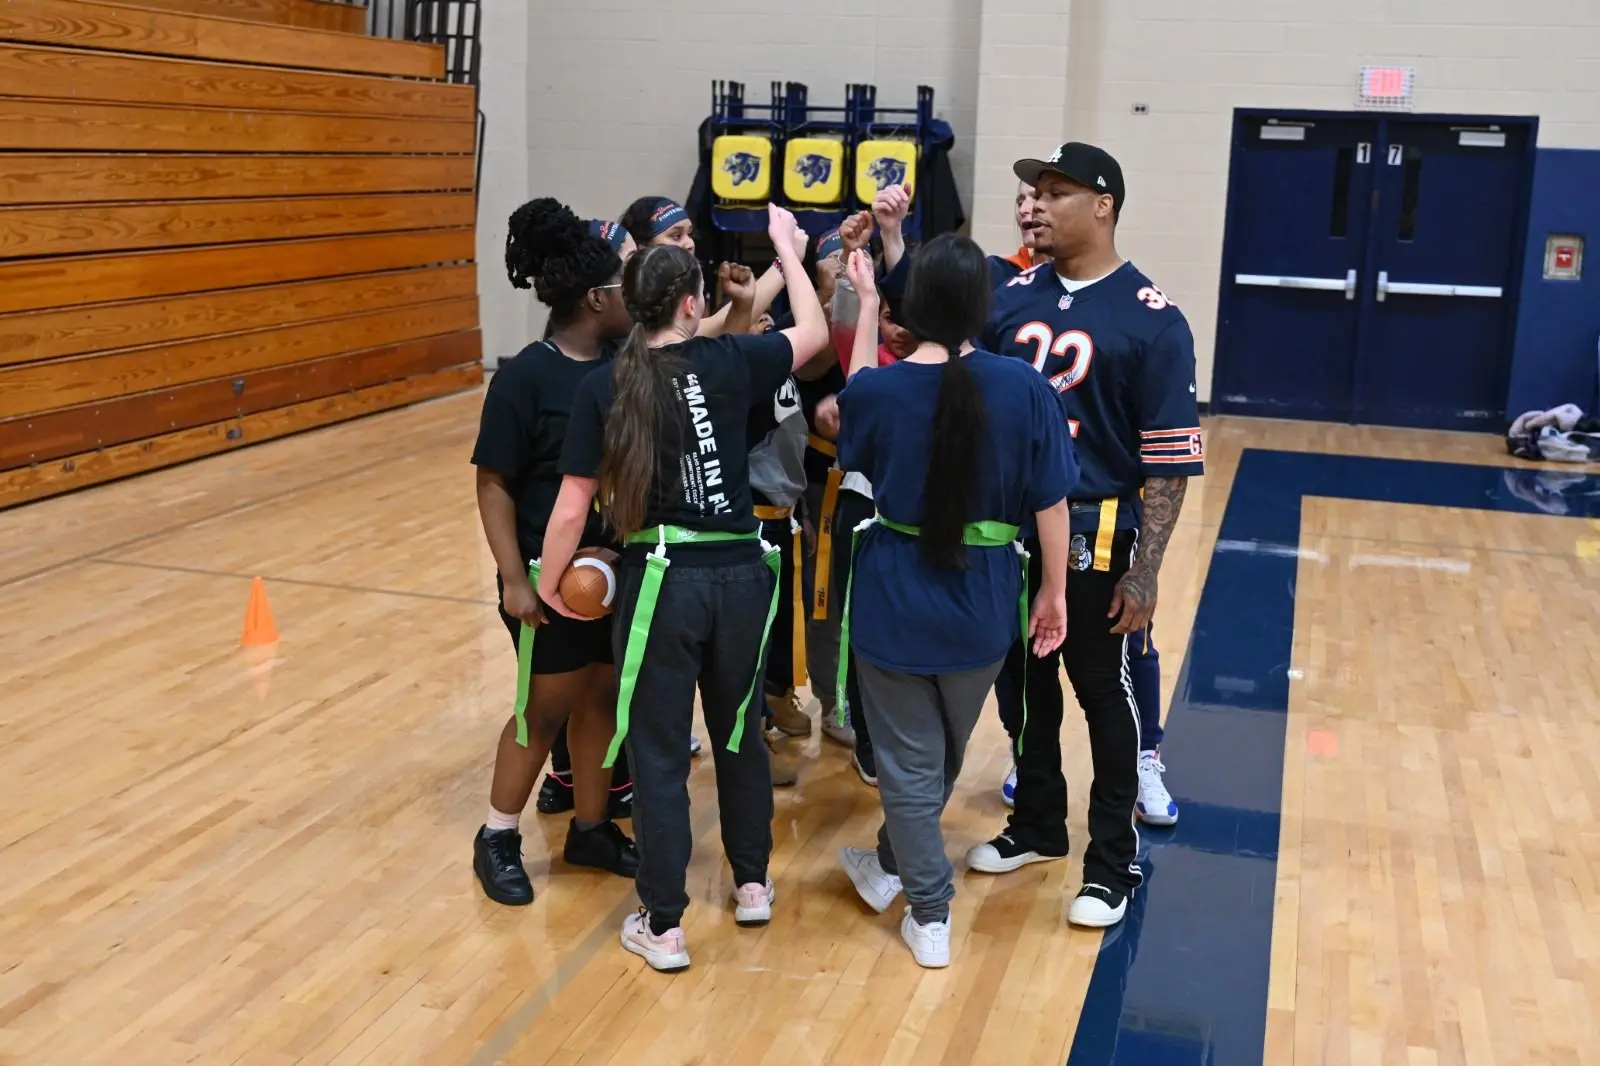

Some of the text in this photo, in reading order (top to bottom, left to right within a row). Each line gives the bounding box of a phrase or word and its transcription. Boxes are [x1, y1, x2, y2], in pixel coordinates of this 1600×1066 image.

[1361, 144, 1401, 164] 1 7
[703, 459, 723, 487] IN
